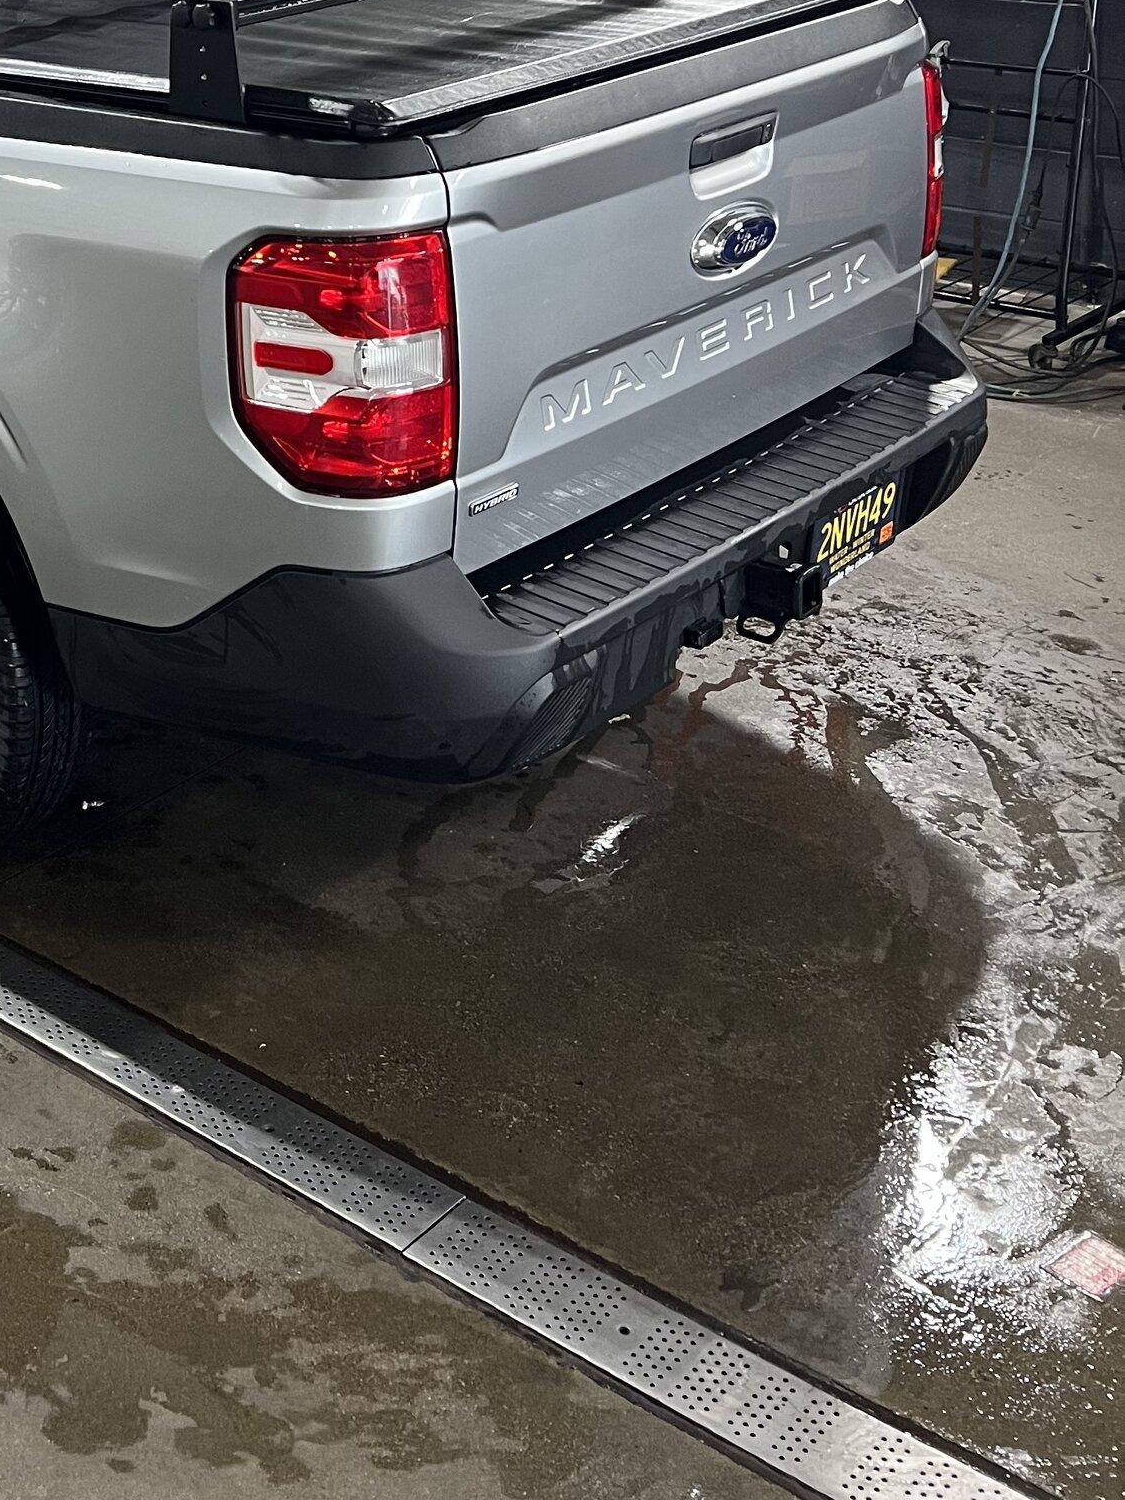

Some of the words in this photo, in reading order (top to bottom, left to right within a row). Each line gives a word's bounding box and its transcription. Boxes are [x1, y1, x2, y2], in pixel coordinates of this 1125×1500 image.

[540, 253, 871, 432] MAVERICK
[474, 488, 518, 514] HYBRID
[817, 482, 897, 563] 2NVH49
